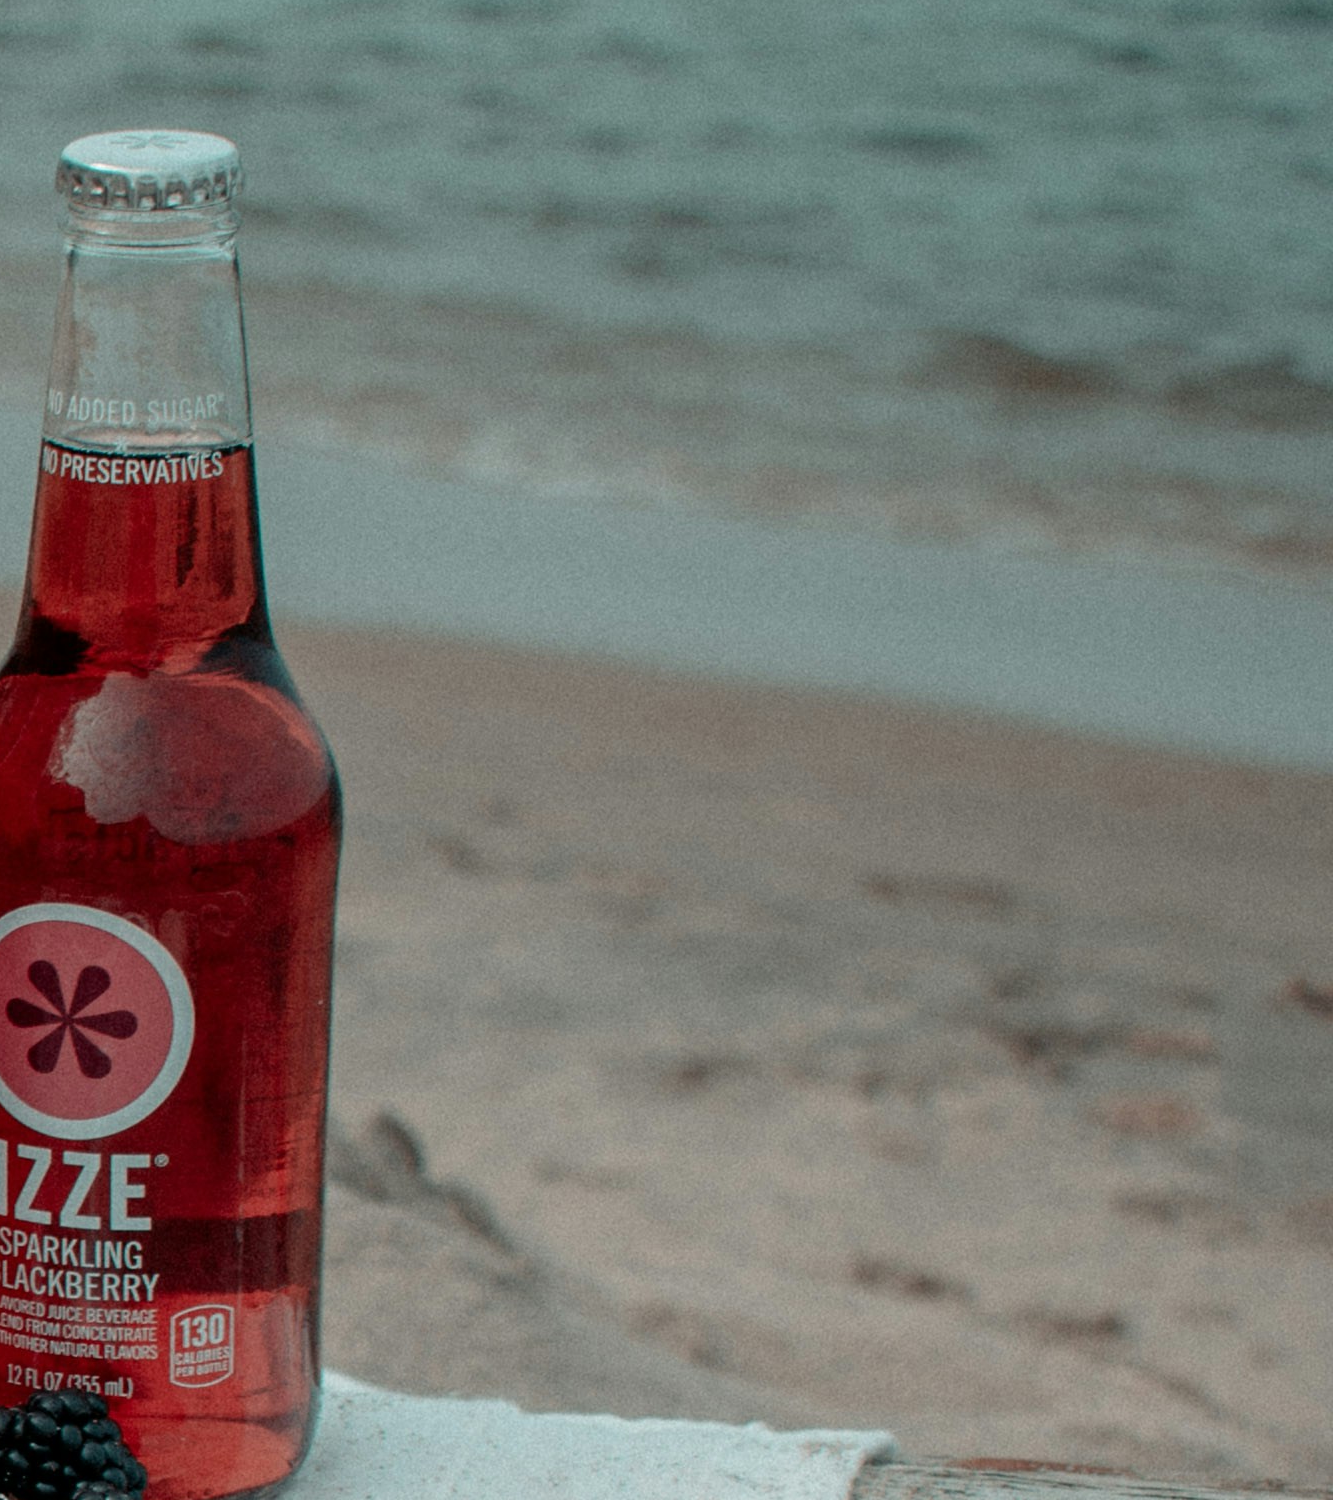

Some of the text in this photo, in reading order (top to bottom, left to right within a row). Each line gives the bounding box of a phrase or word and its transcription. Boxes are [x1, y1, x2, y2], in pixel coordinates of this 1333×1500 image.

[66, 394, 136, 425] ADDED
[60, 451, 224, 484] PRESERVATIVES
[47, 1304, 83, 1322] JUICE
[86, 1308, 158, 1325] BEVERAGE
[25, 1317, 61, 1338] FROM
[62, 1323, 158, 1342] CONCENTRATE
[179, 1312, 225, 1349] 130
[13, 1332, 48, 1353] OTHER
[49, 1340, 103, 1360] NATURAL
[104, 1345, 158, 1361] FLAVORS
[174, 1347, 231, 1366] CALORIES
[6, 1363, 22, 1385] 12
[24, 1367, 42, 1391] FL
[104, 1376, 134, 1399] mL)
[175, 1366, 193, 1377] PER
